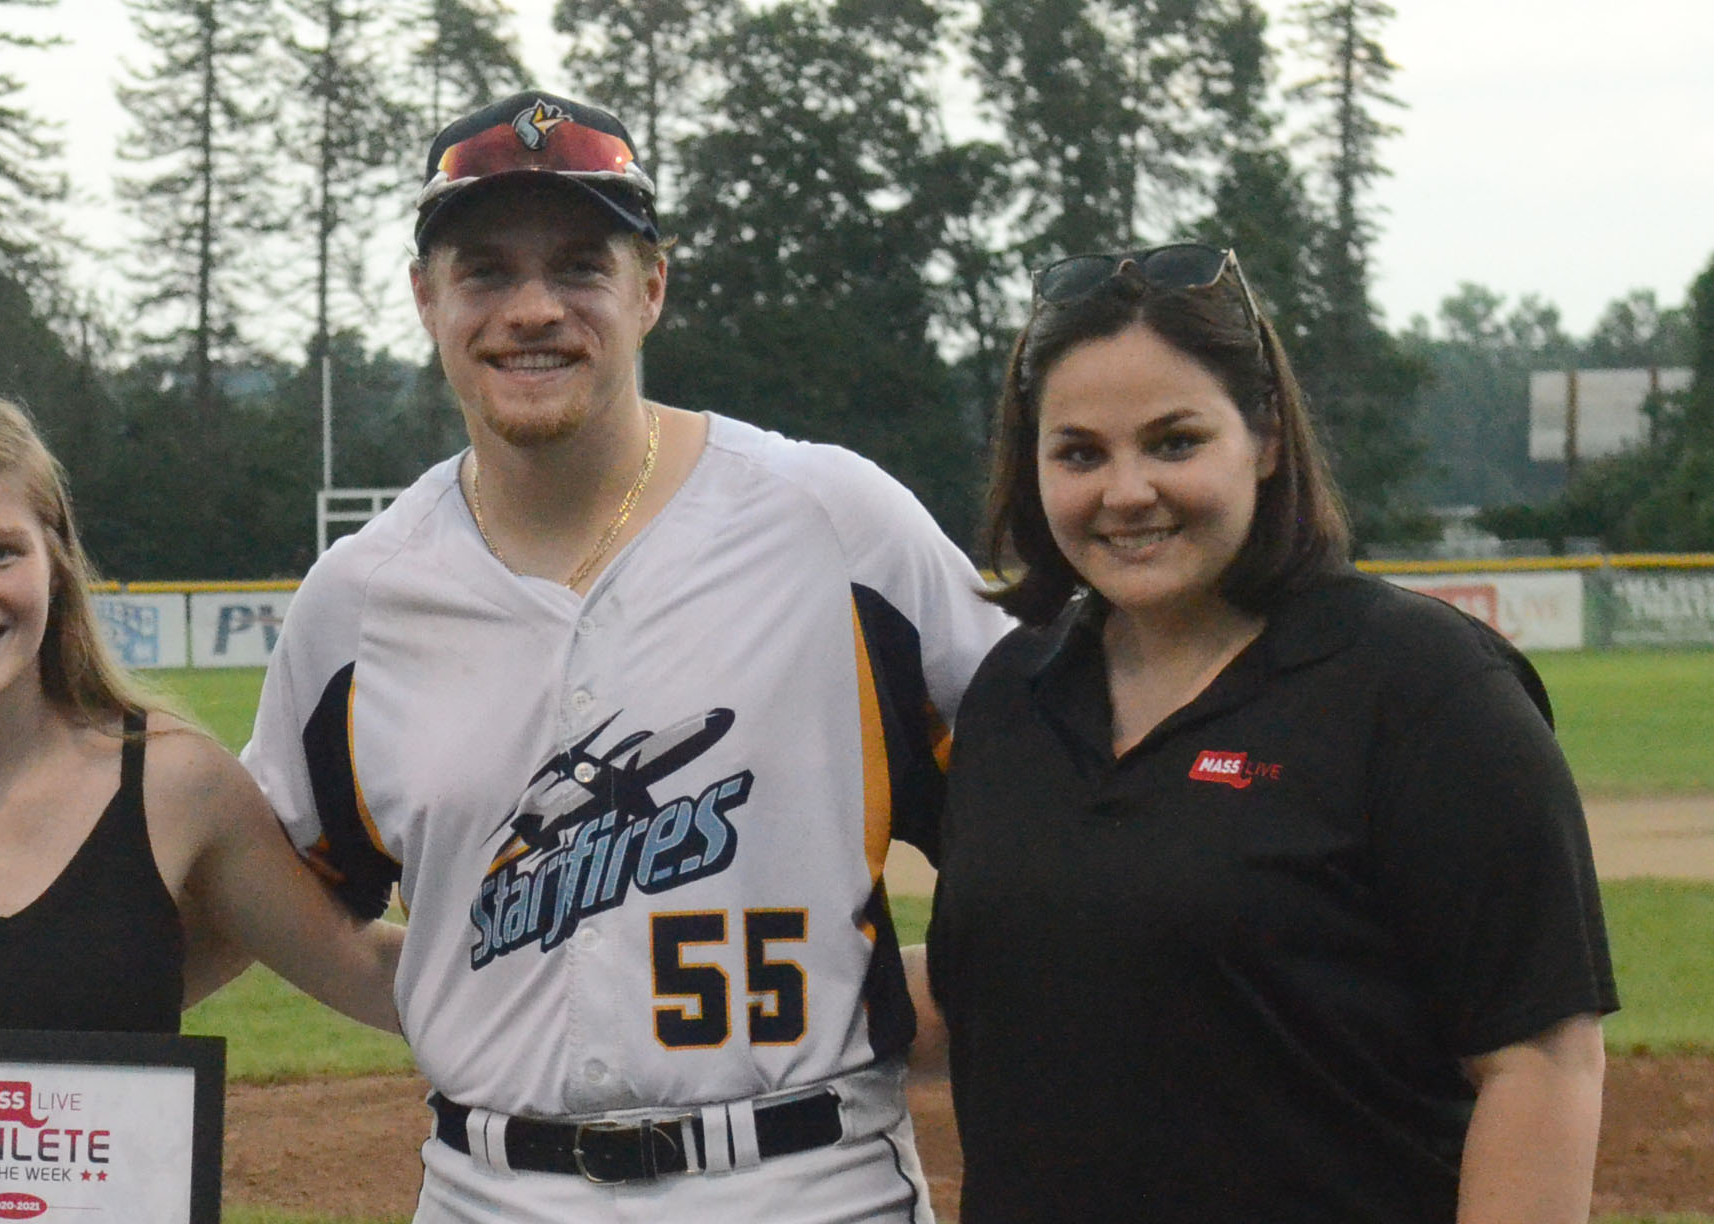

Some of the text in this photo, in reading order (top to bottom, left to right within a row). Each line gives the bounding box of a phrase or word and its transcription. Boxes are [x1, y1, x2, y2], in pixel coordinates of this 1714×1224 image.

[1198, 757, 1284, 780] MASS LIVE
[470, 769, 755, 971] Starfires
[648, 907, 809, 1051] 55
[37, 1092, 83, 1111] LIVE
[25, 1167, 72, 1182] WEEK
